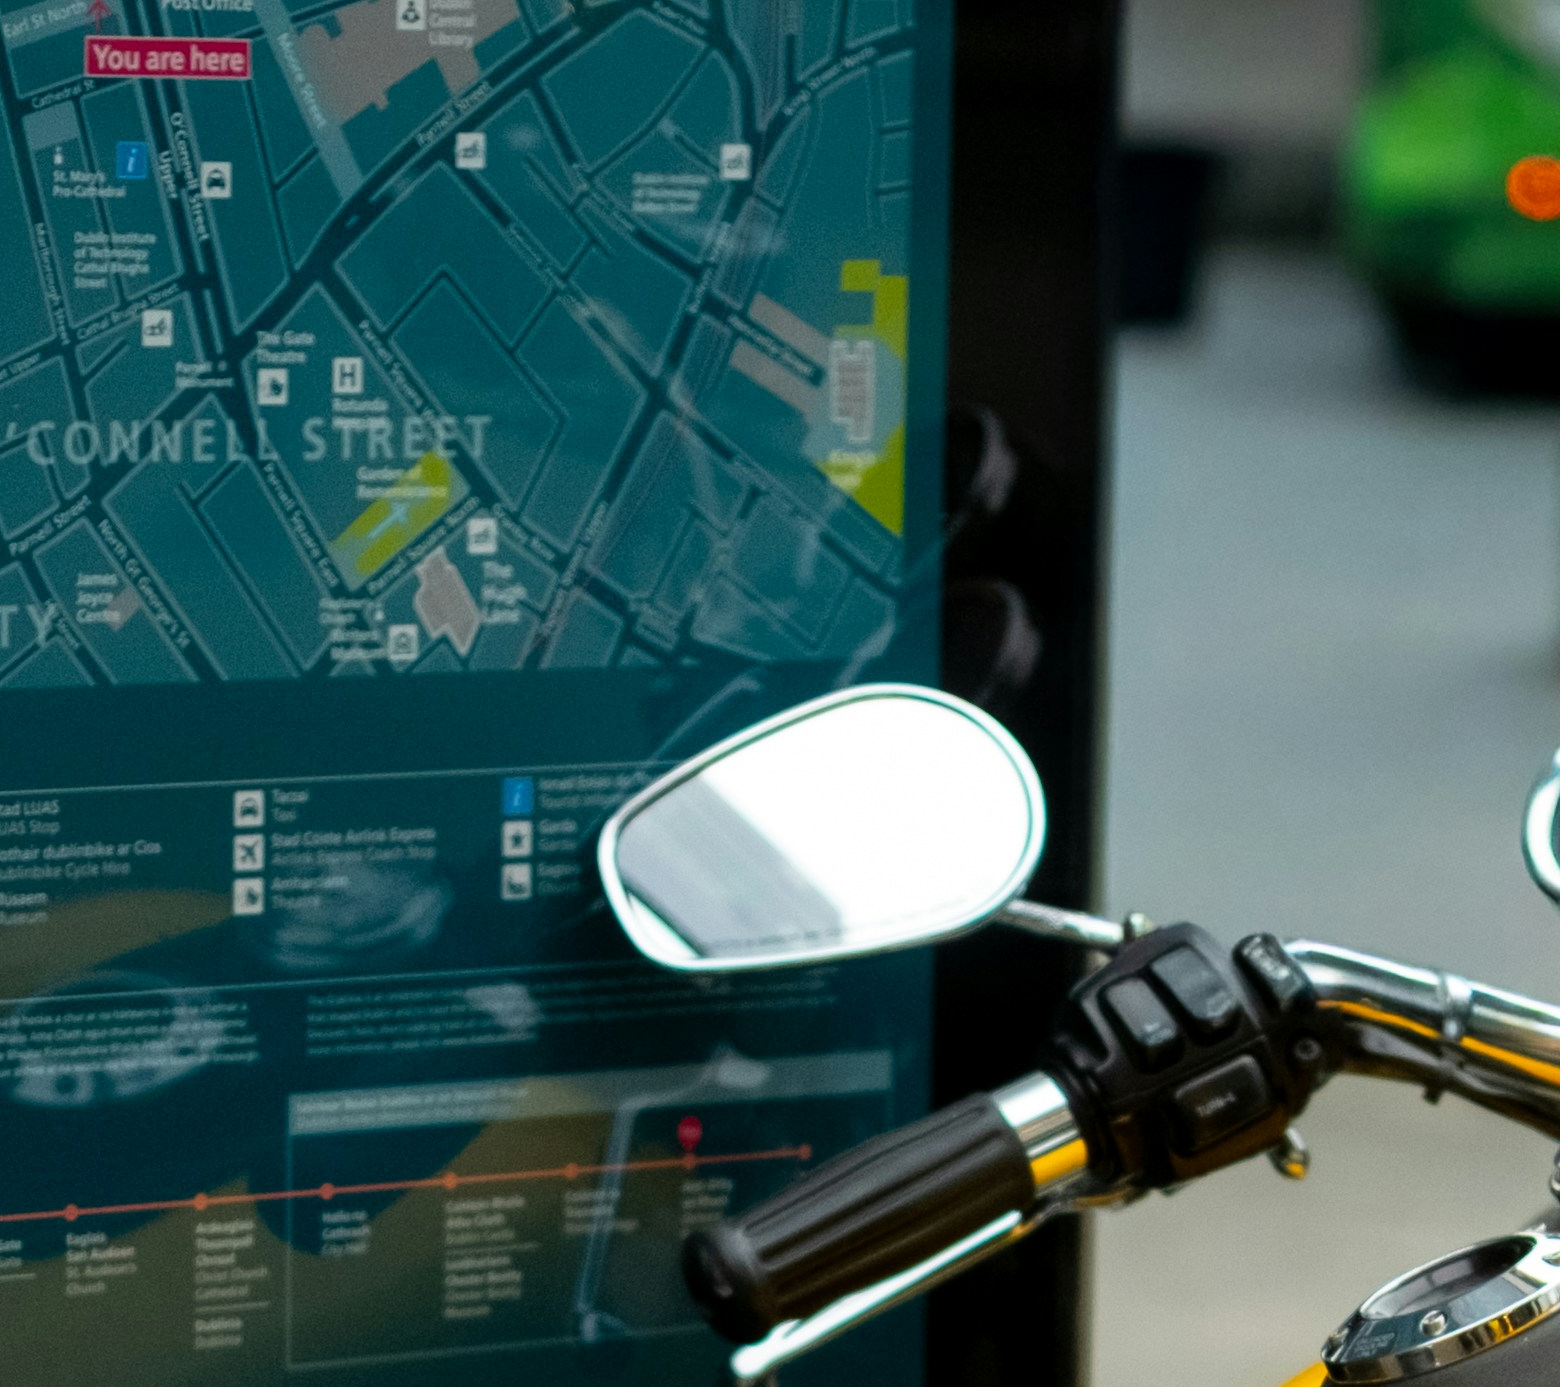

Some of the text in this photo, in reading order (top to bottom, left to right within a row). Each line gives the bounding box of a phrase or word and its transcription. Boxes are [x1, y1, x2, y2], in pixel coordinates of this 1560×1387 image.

[93, 43, 245, 72] You are here
[301, 414, 493, 462] STREET
